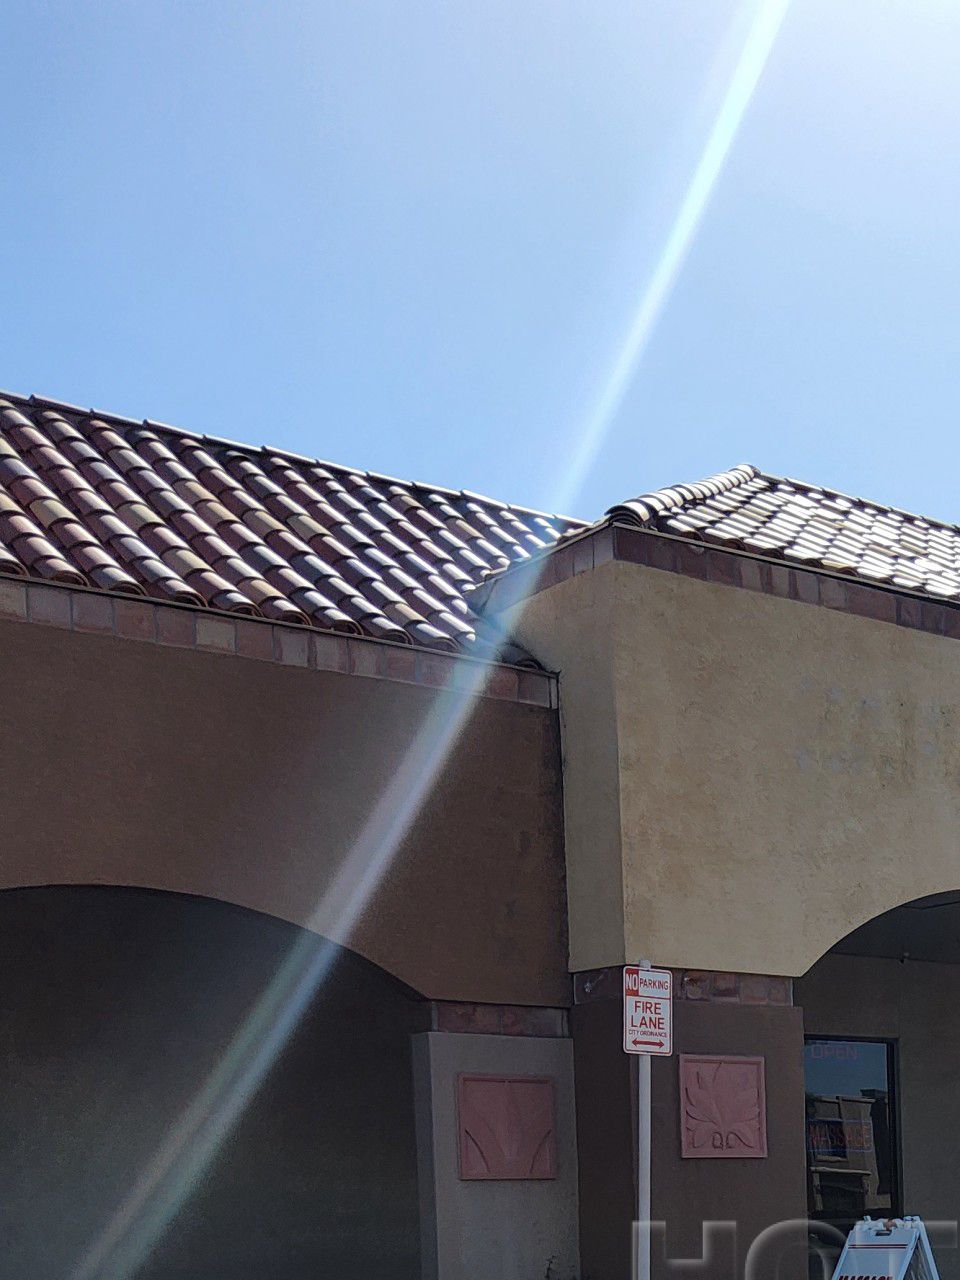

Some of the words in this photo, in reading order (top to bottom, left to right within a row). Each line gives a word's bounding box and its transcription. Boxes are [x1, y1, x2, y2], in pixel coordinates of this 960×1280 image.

[625, 973, 639, 991] NO
[639, 977, 669, 991] PARKING
[634, 1000, 662, 1015] FIRE
[630, 1014, 665, 1031] LANE
[640, 1030, 668, 1039] ORDINANCE
